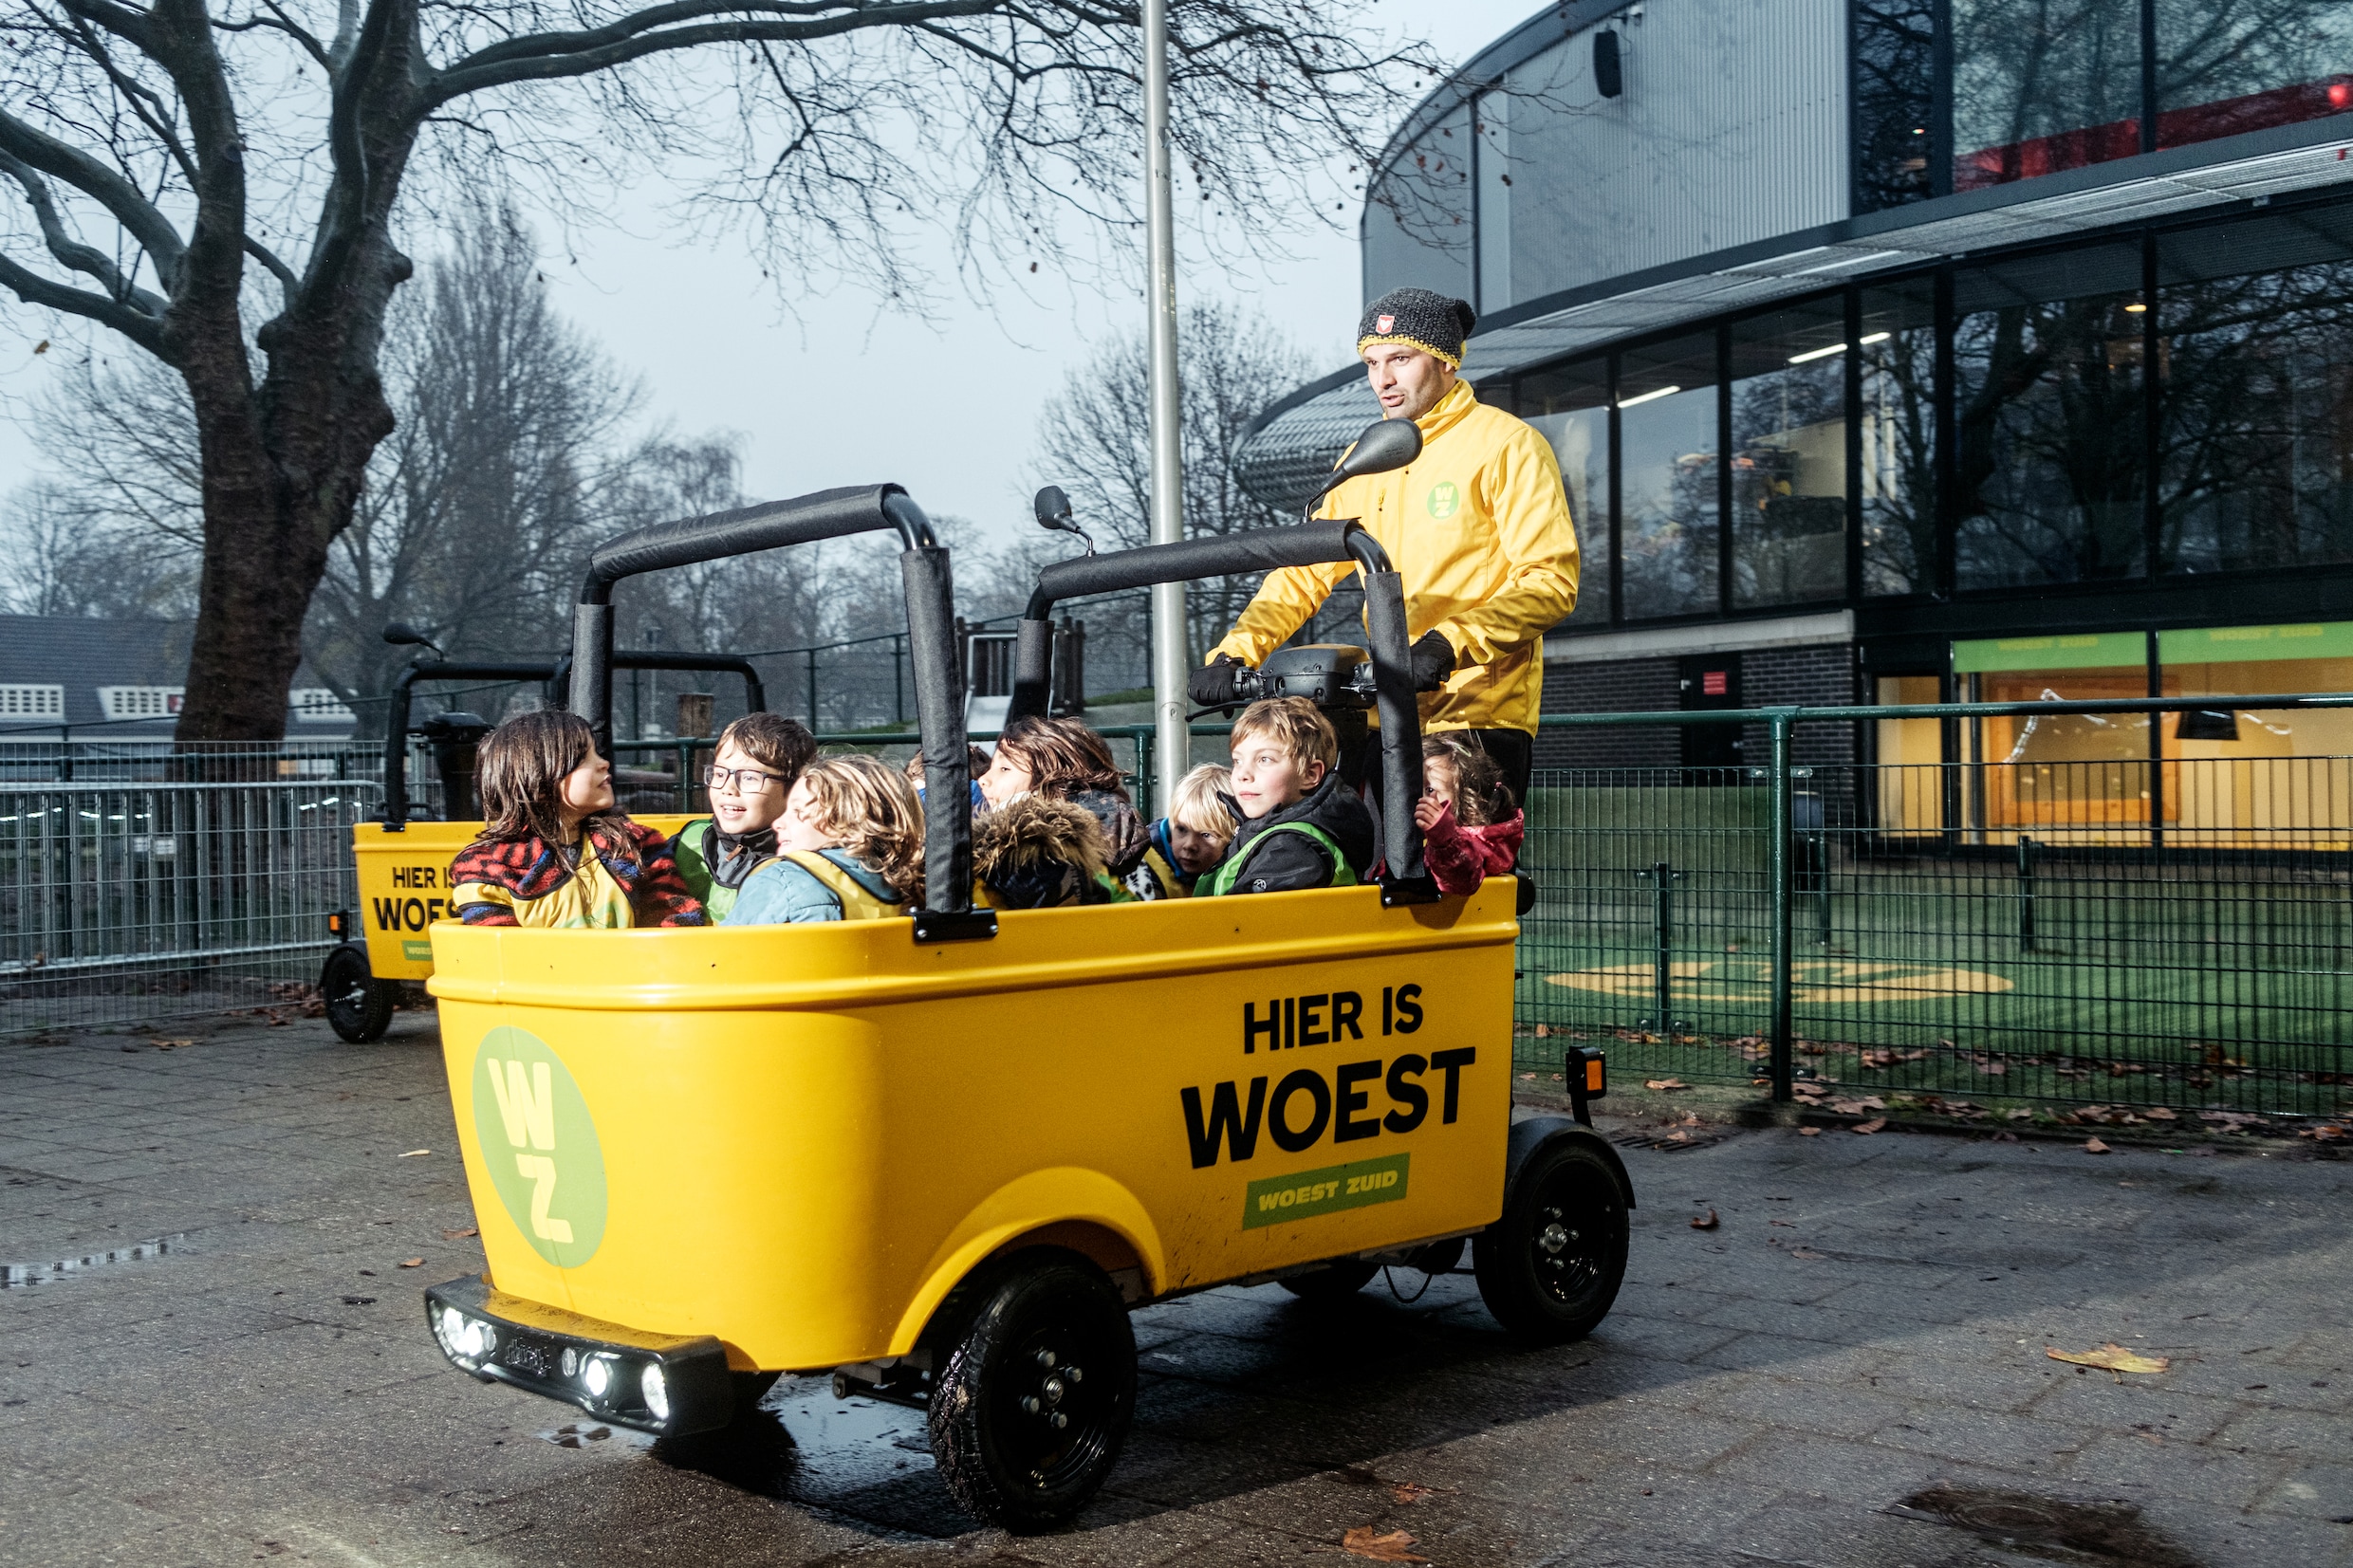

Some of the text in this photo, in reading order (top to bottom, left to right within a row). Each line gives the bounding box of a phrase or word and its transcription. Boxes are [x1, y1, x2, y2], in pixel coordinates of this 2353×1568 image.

[393, 867, 436, 889] HIER
[1244, 983, 1423, 1054] HIER IS
[488, 1058, 555, 1150] W
[1180, 1046, 1475, 1169] WOEST
[1258, 1170, 1399, 1211] WOEST ZUID
